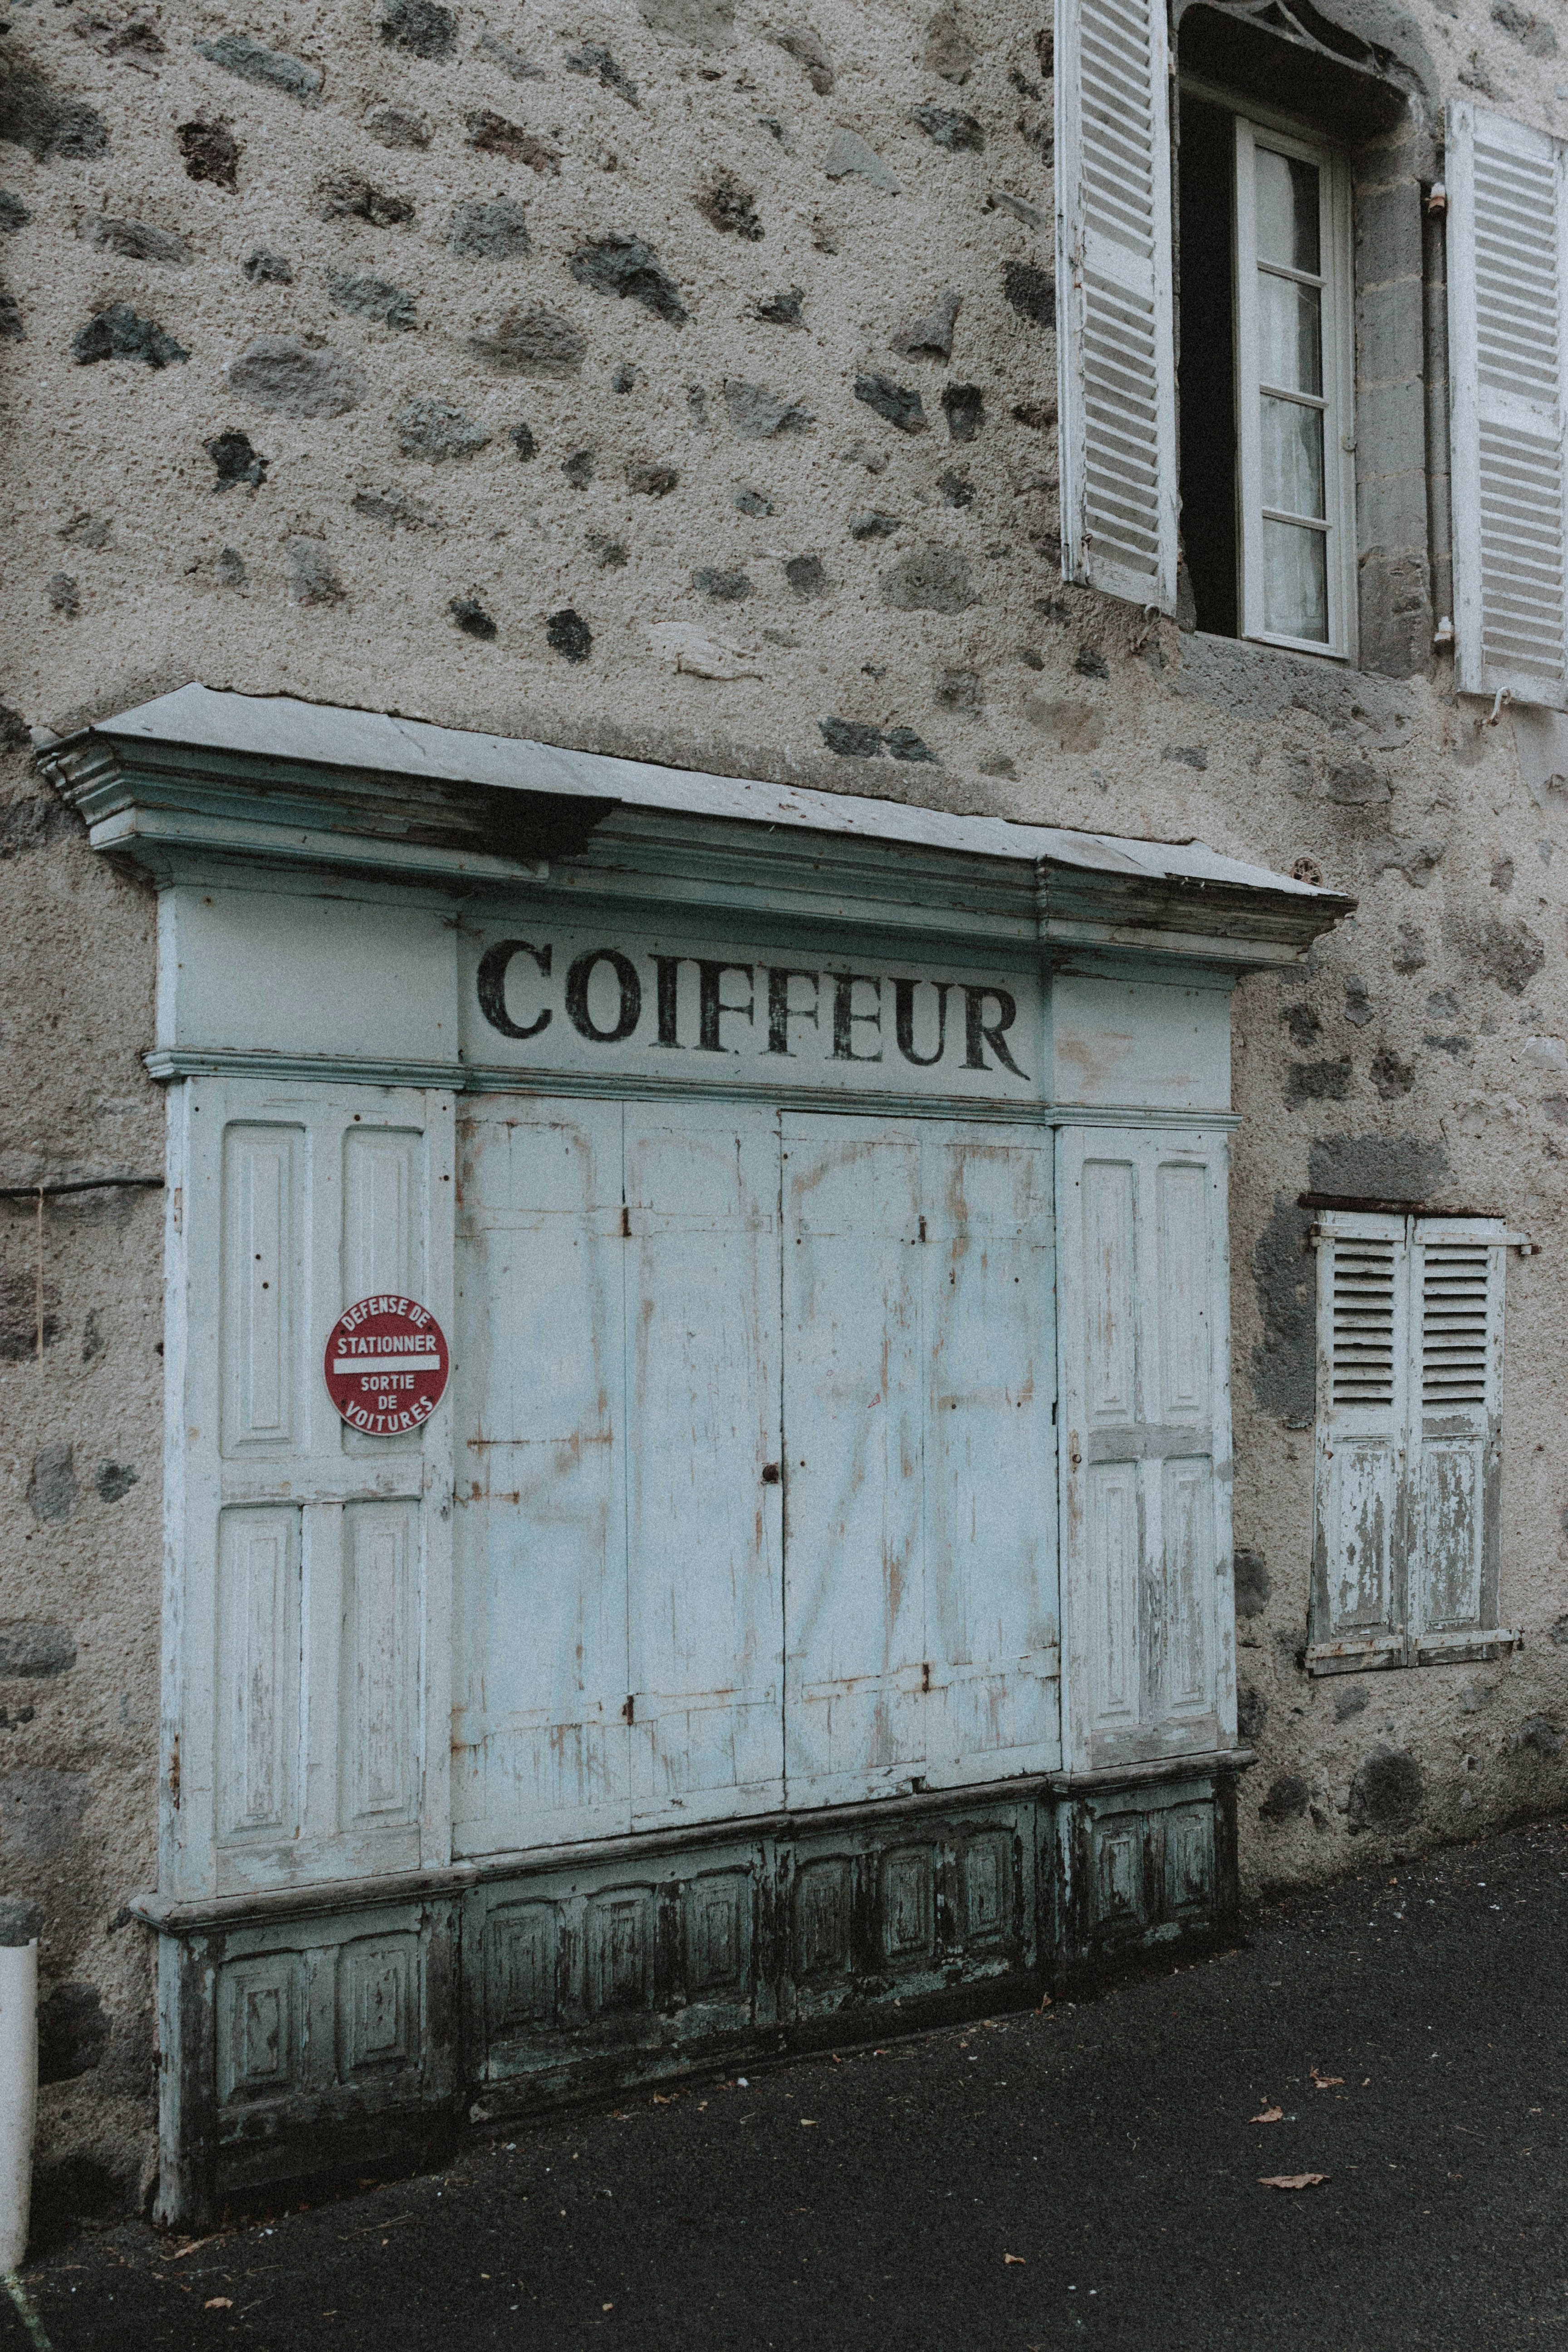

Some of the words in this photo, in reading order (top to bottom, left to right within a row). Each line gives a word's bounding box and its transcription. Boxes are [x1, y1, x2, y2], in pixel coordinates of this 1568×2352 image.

[477, 939, 1031, 1081] COIFFEUR
[341, 1297, 409, 1331] DEFENSE
[409, 1305, 431, 1328] DE
[338, 1335, 437, 1354] STATIONNER
[361, 1375, 415, 1391] SORTIE
[345, 1396, 433, 1431] VOITURES
[378, 1395, 397, 1410] DE
